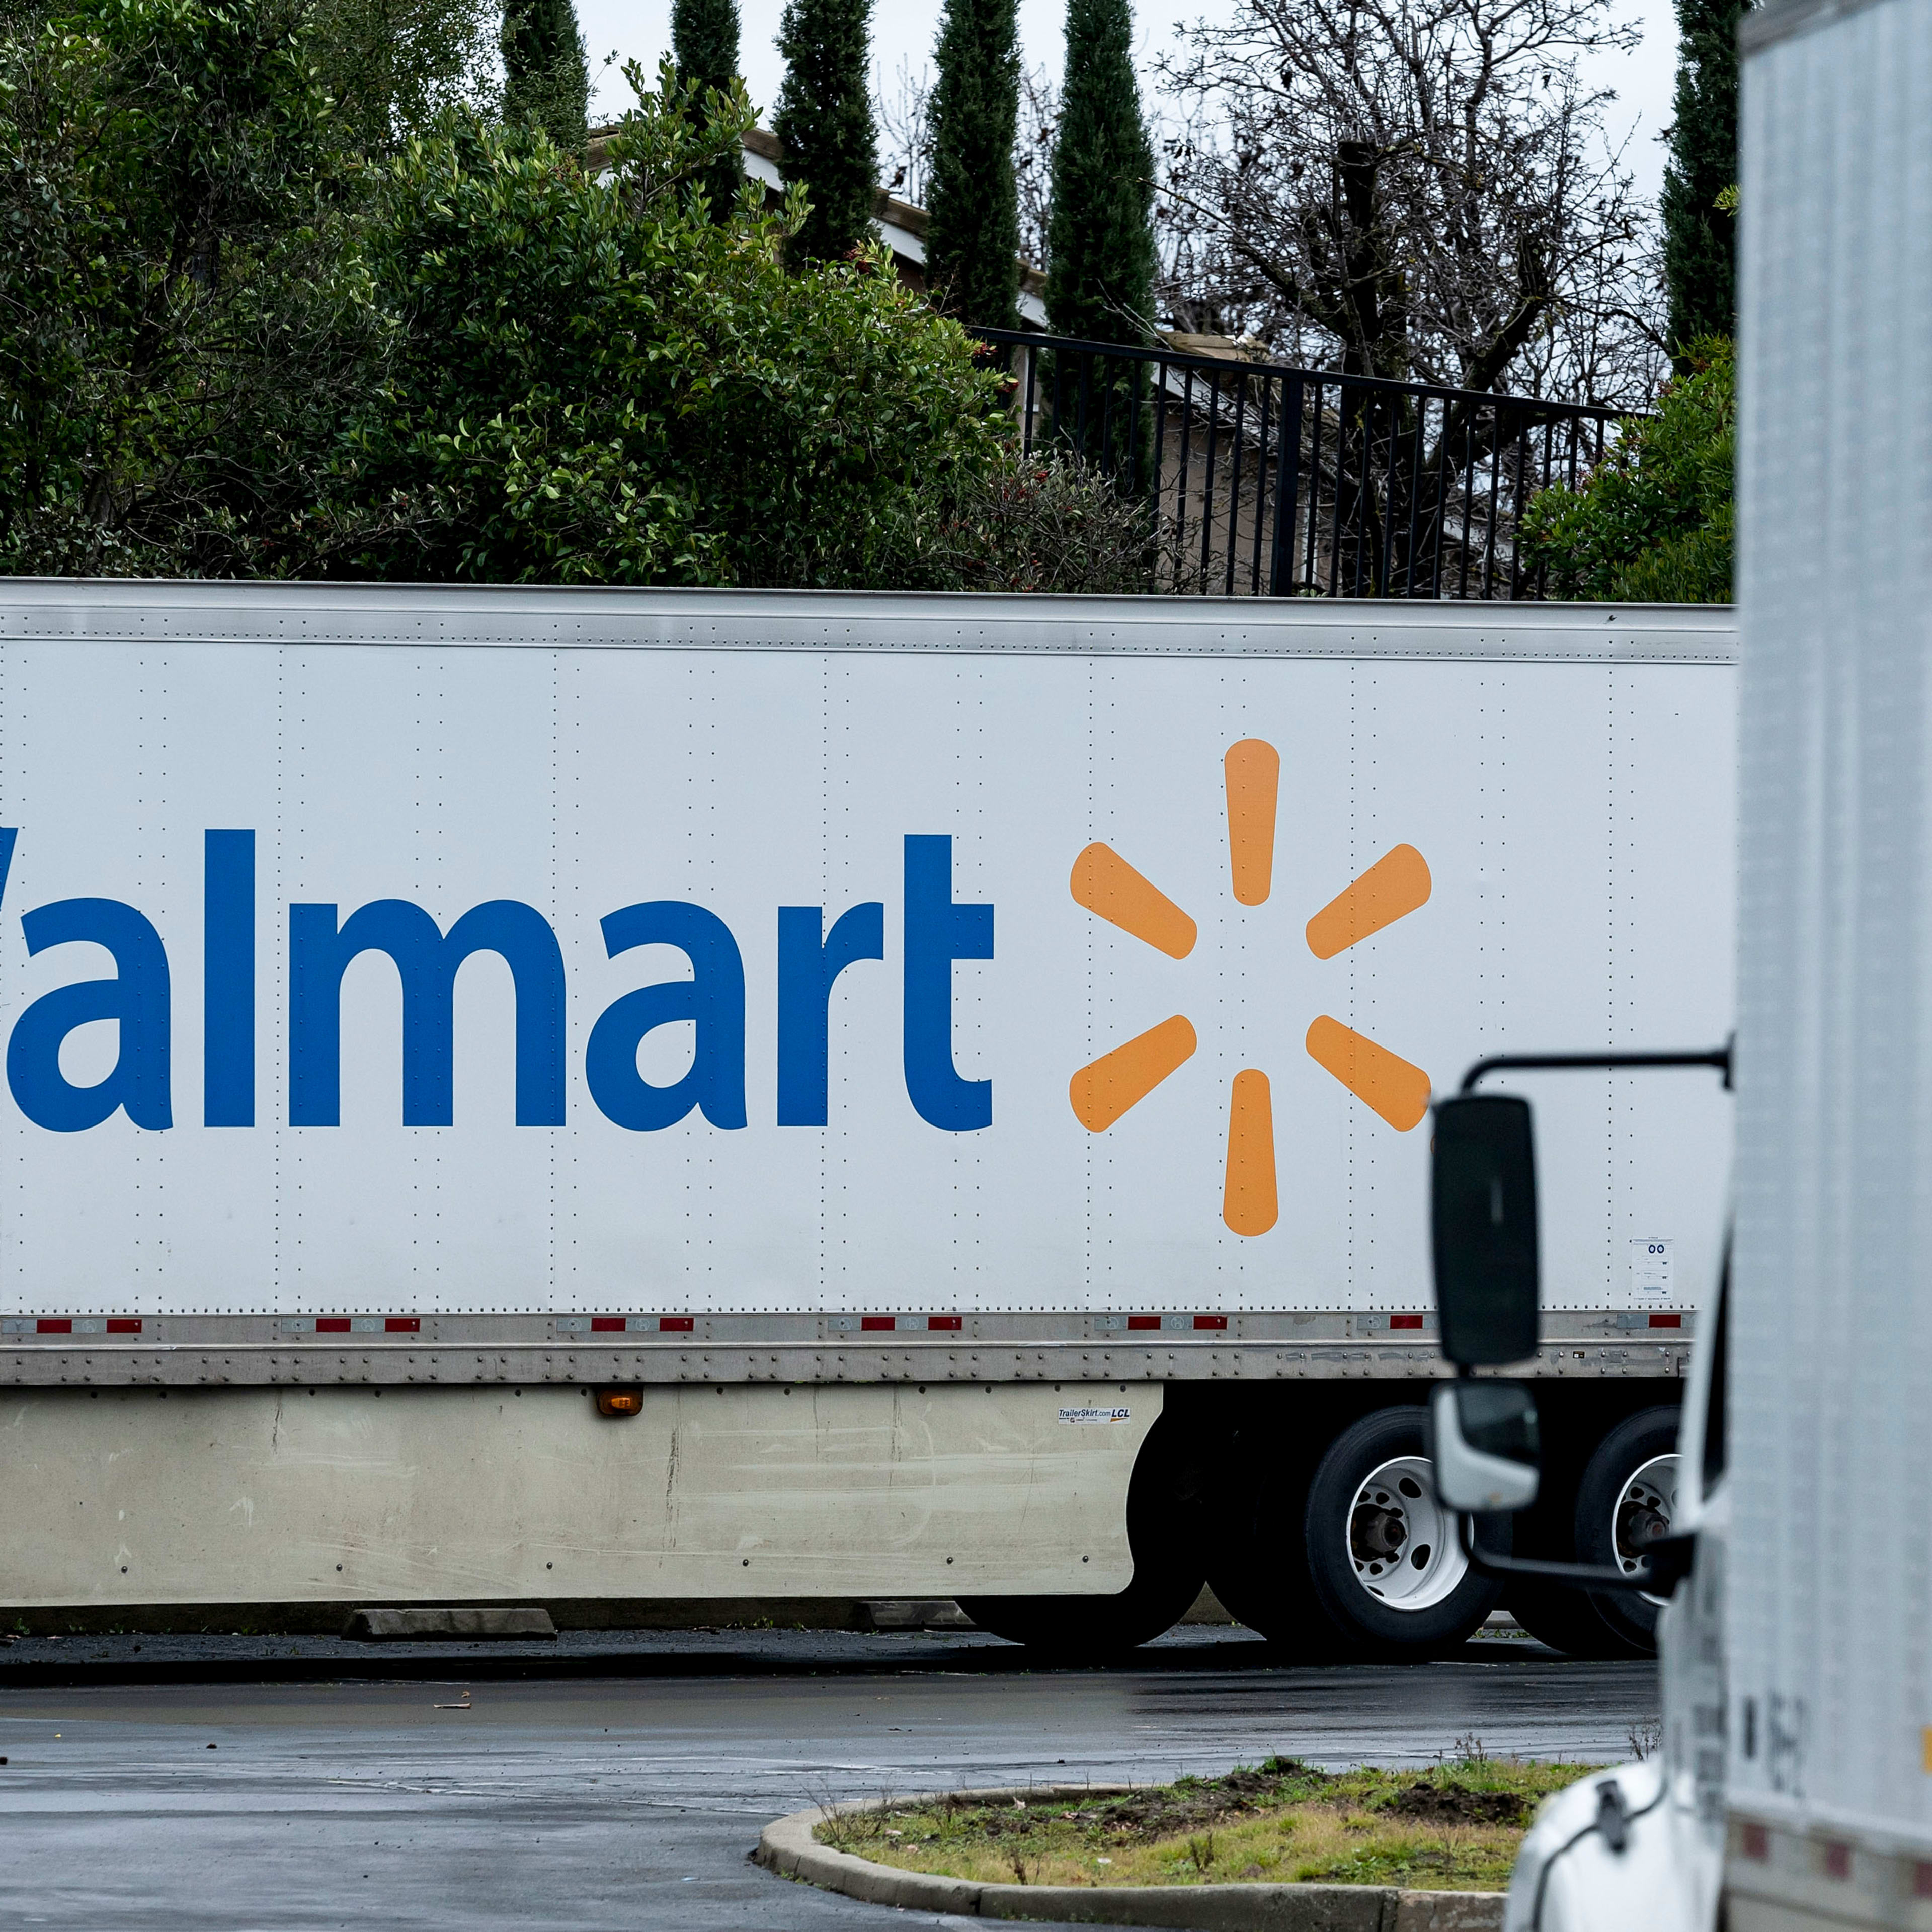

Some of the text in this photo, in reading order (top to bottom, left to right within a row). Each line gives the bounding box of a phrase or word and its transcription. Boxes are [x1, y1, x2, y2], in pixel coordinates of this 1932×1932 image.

[0, 827, 994, 1132] almart
[1059, 1409, 1130, 1417] TrailerSkirt.com LCL
